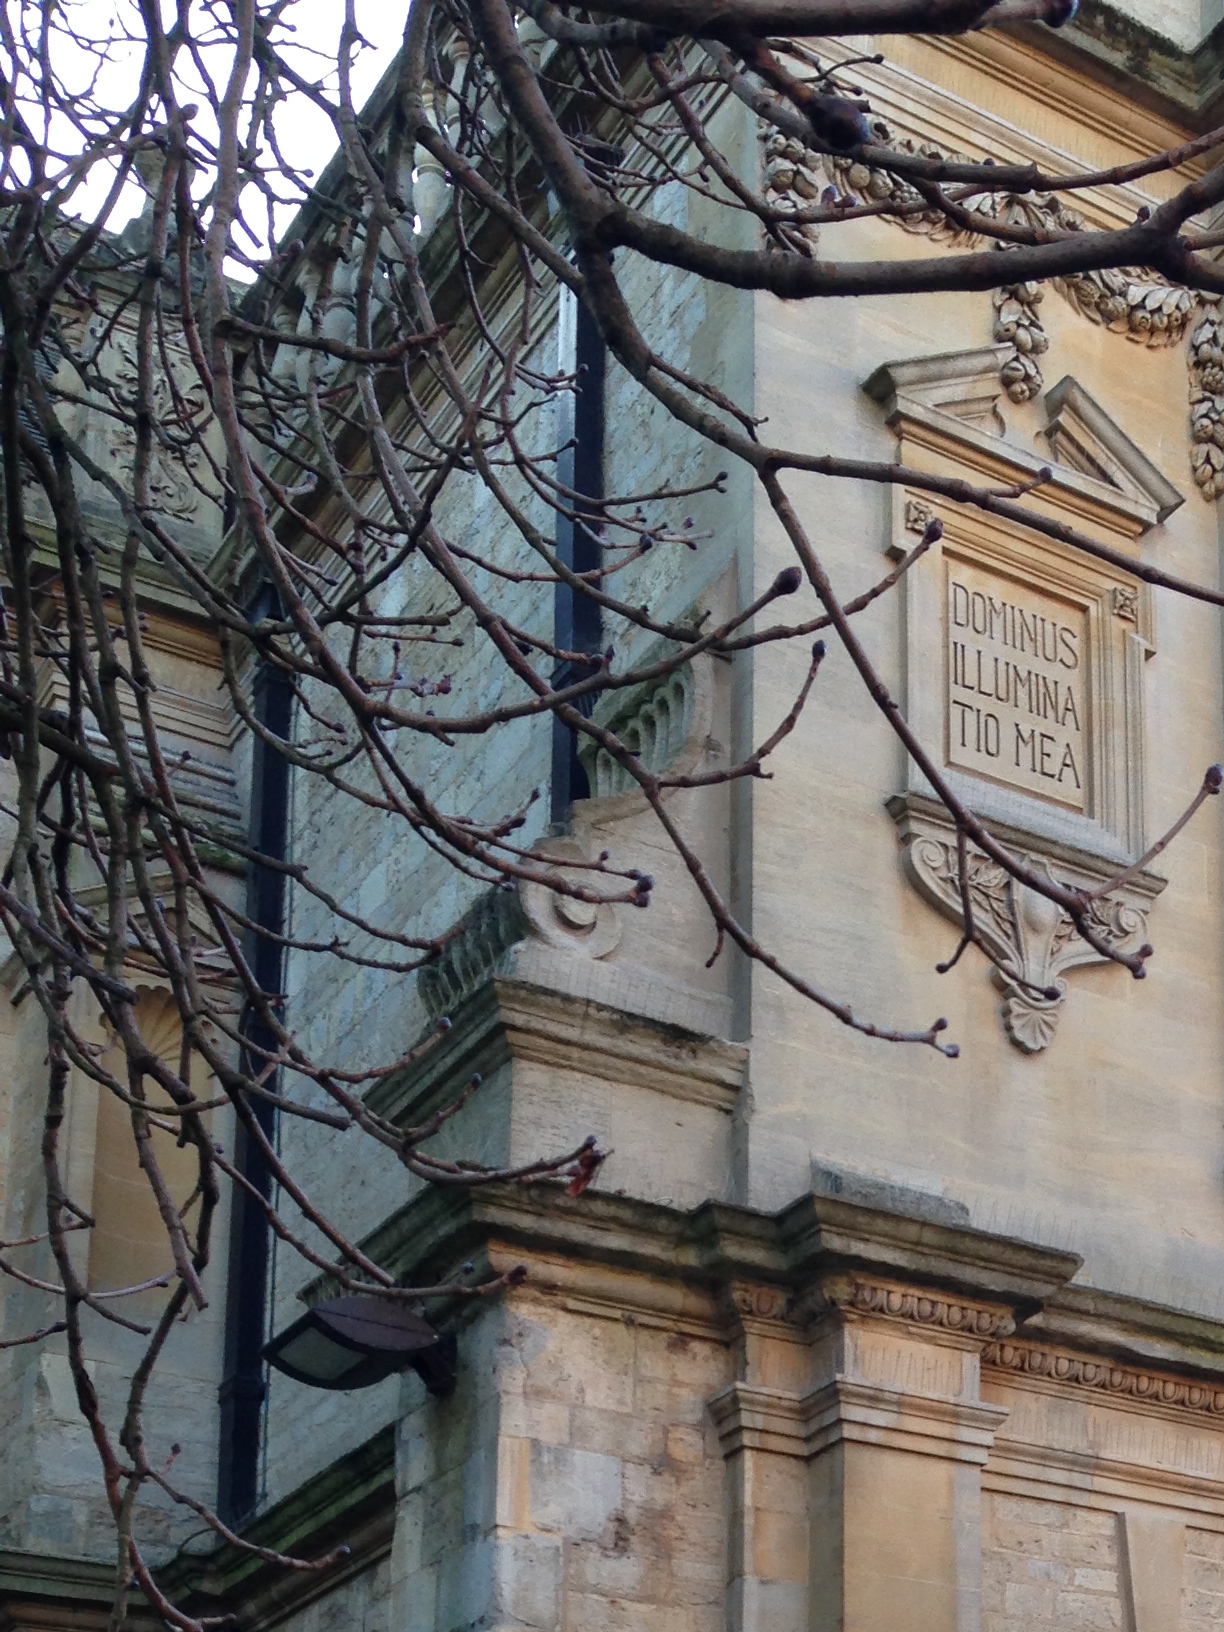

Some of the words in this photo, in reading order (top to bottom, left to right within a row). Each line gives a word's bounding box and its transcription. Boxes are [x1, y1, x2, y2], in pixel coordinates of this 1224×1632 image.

[951, 581, 1079, 670] DOMINUS
[951, 641, 1081, 732] ILLUMINA
[951, 699, 1000, 758] TIO
[1014, 722, 1081, 789] MEA
